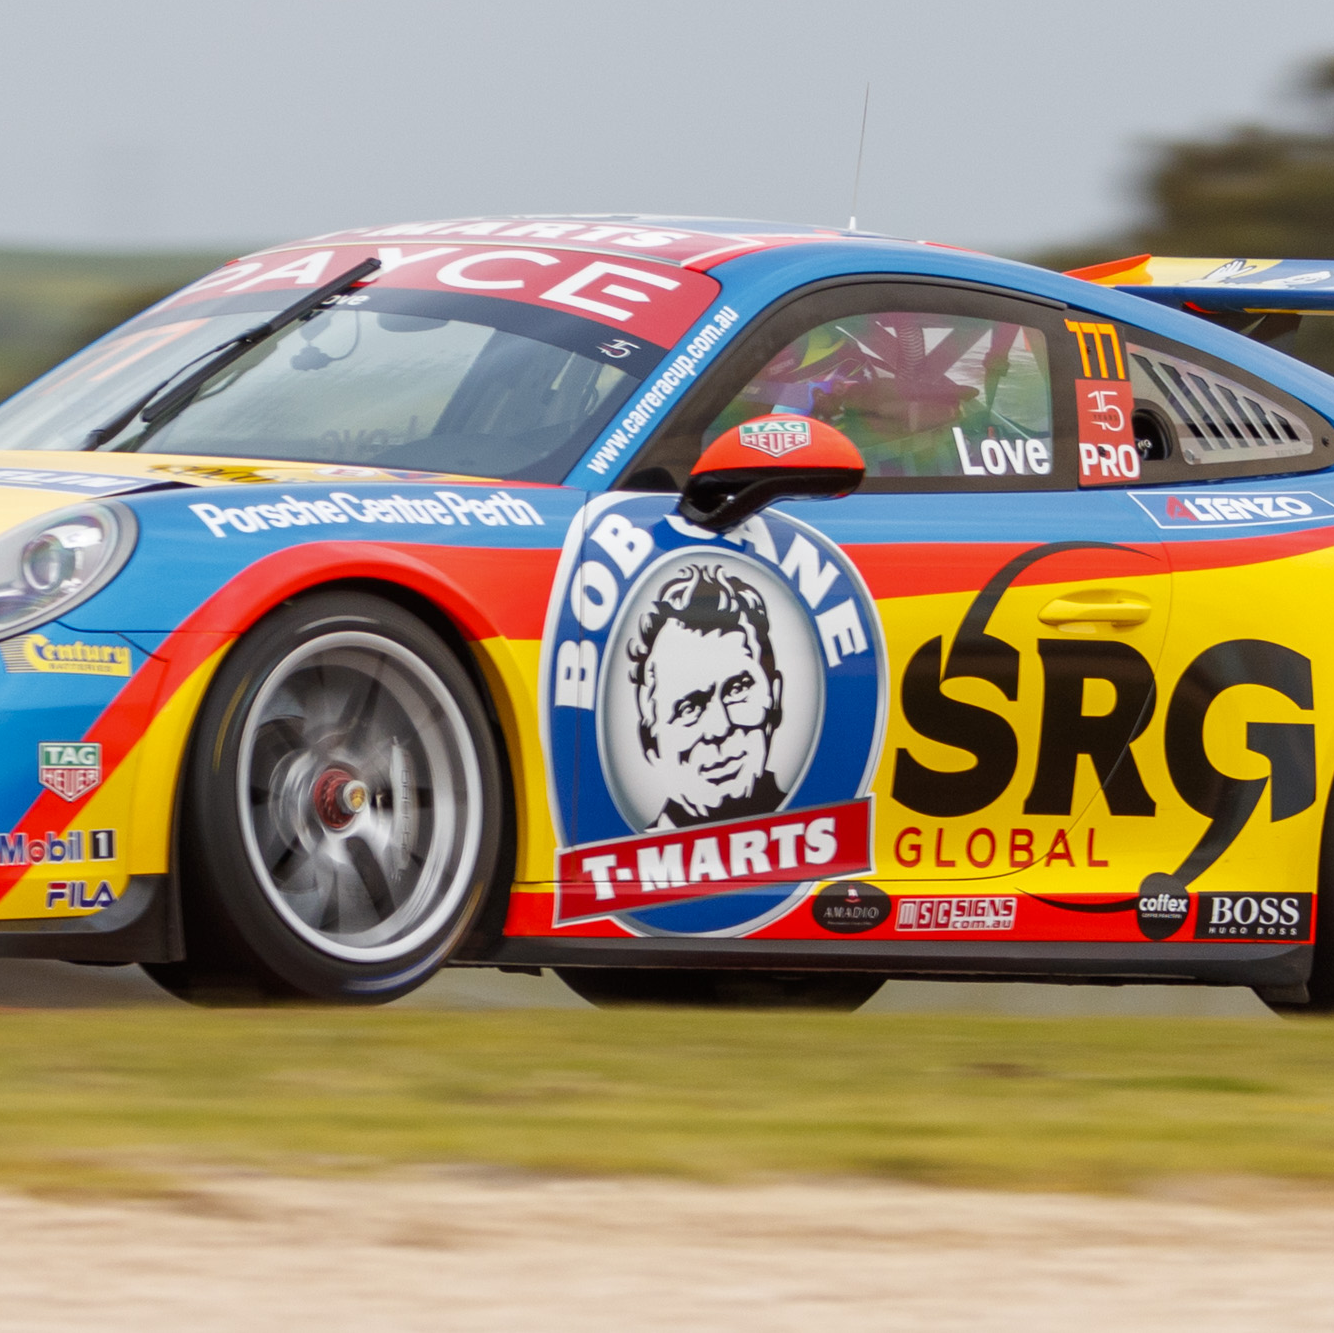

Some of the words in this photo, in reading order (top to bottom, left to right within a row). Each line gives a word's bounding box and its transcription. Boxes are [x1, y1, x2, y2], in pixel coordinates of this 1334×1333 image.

[143, 247, 681, 322] PAYCE
[320, 294, 372, 306] ove
[1064, 318, 1126, 380] 777
[586, 305, 740, 475] www.carreracup.com.au
[1087, 390, 1124, 432] 15
[744, 421, 805, 433] TAG
[744, 433, 806, 453] HEUER
[952, 426, 1050, 476] Love
[1079, 443, 1141, 479] PRO
[188, 494, 345, 538] Porsche
[328, 492, 448, 526] Centre
[434, 491, 546, 526] Perth
[1165, 496, 1313, 522] ALTENZO
[555, 514, 654, 710] BOB
[24, 633, 130, 665] Century
[891, 541, 1317, 841] SRG
[44, 746, 96, 765] TAG
[42, 769, 99, 798] HEUER
[581, 817, 838, 901] T-MARTS
[895, 827, 1110, 868] GLOBAL
[46, 881, 115, 909] FILA
[952, 899, 1013, 917] SIGNS
[1139, 894, 1189, 913] coffex
[823, 906, 880, 919] AMADIO
[1208, 896, 1301, 926] BOSS
[1208, 926, 1249, 935] HUGO
[1256, 926, 1298, 936] BOSS
